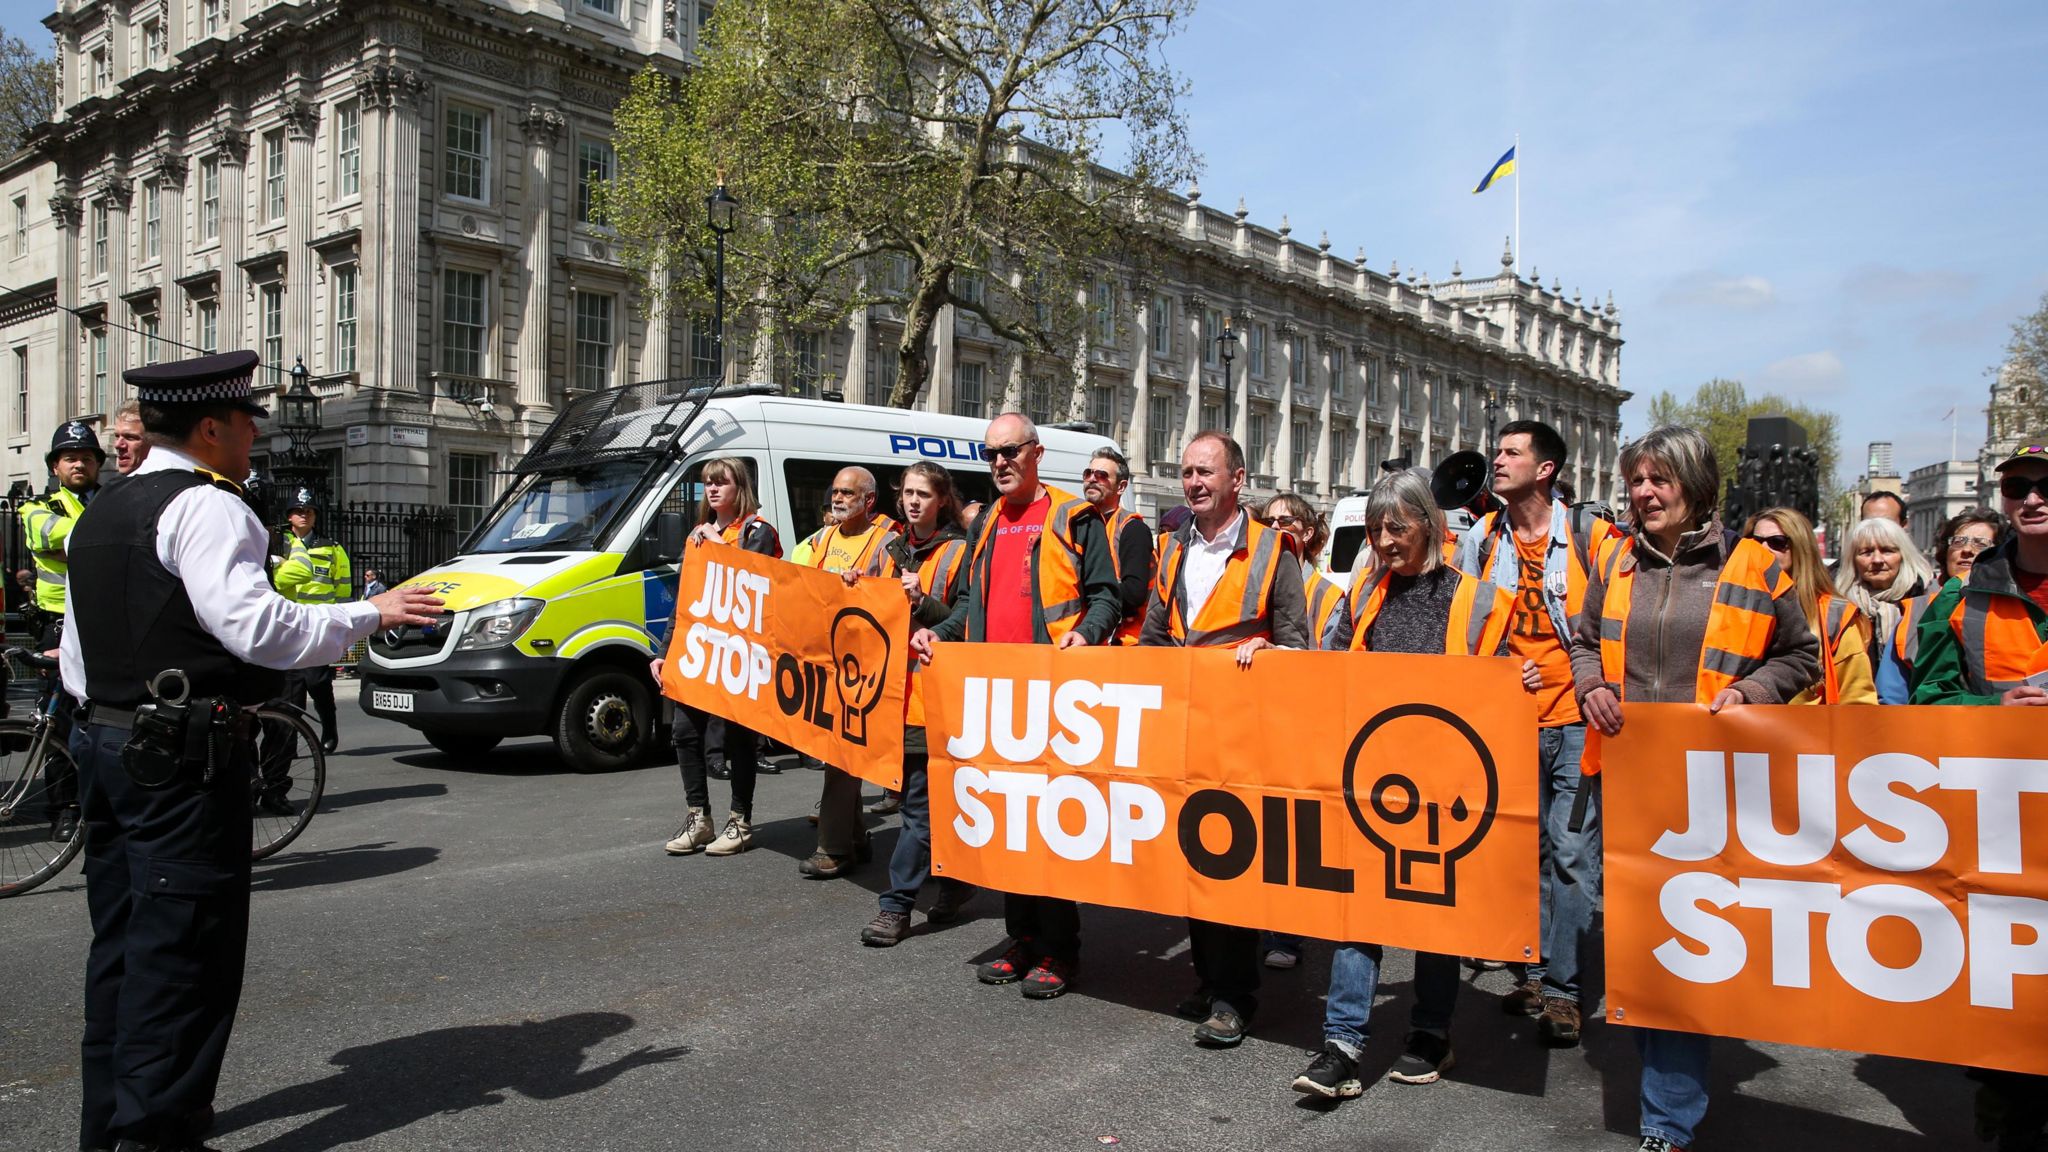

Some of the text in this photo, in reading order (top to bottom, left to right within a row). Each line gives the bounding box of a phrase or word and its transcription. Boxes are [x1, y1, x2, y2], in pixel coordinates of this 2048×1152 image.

[889, 434, 988, 461] POLI
[828, 547, 851, 562] kers
[1010, 525, 1023, 533] OF
[1344, 514, 1366, 522] POLIC
[688, 561, 770, 634] JUST
[393, 695, 409, 709] DJJ
[678, 622, 834, 731] STOP OIL
[947, 677, 1162, 769] JUST
[953, 766, 1355, 894] STOP OIL
[1650, 751, 2048, 874] JUST
[1652, 872, 2048, 1010] STOP
